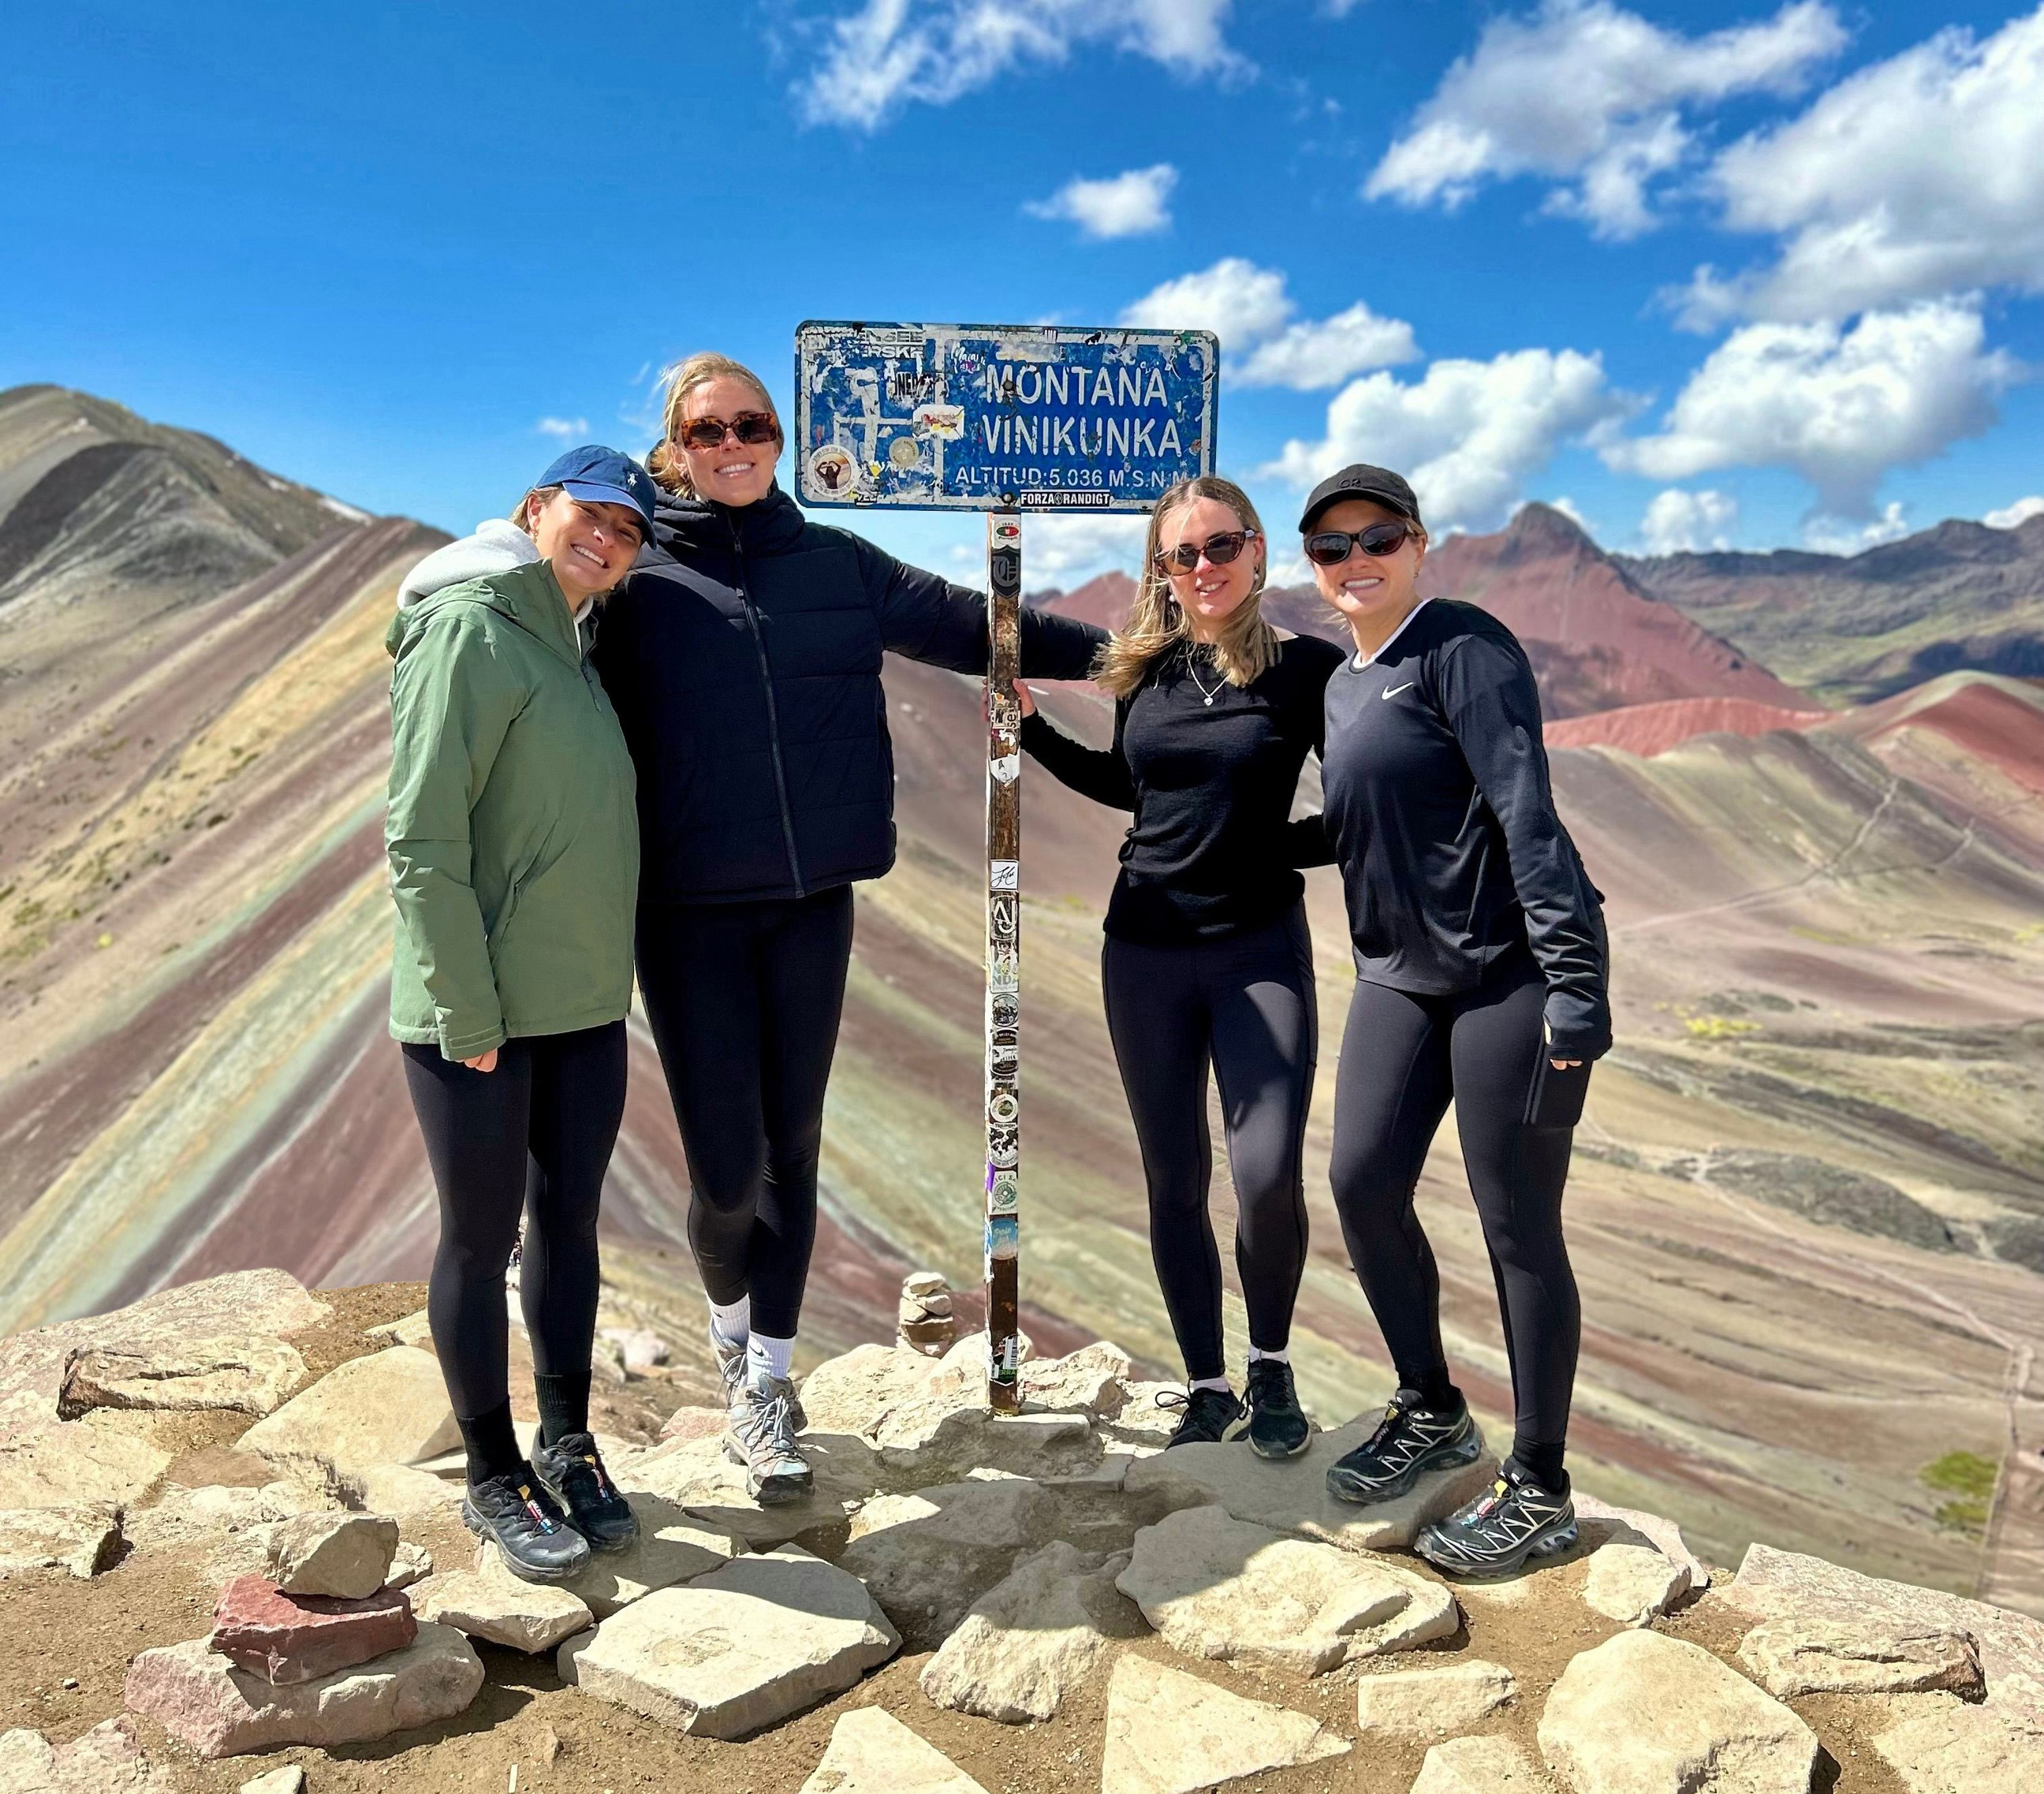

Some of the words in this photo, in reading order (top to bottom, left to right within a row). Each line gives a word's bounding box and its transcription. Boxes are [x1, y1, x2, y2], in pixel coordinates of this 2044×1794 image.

[986, 364, 1167, 407] MONTANA
[981, 414, 1182, 458] VINIKUNKA
[1021, 493, 1055, 505] FORZA
[1063, 493, 1110, 505] RANDIGT
